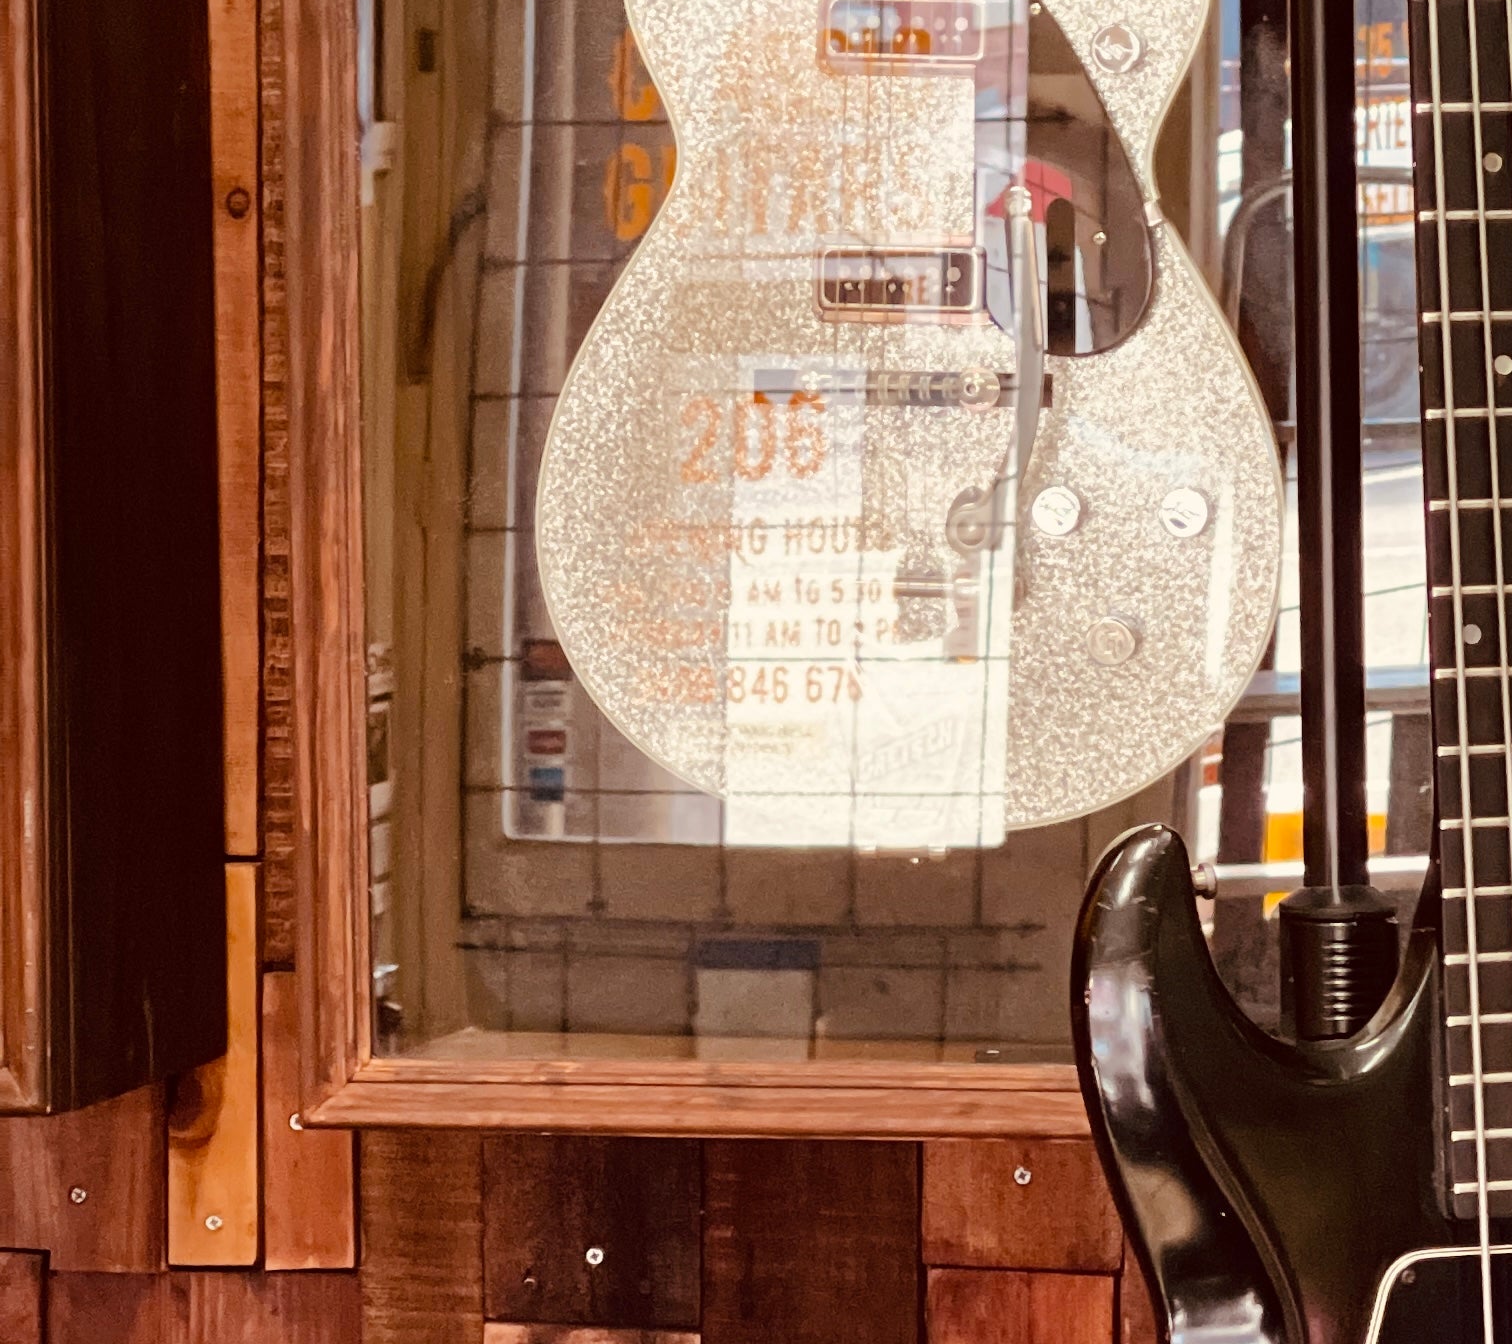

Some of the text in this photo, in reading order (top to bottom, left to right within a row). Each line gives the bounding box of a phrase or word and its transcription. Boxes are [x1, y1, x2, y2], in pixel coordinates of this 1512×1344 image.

[680, 390, 826, 483] 206
[765, 619, 801, 647] AM
[815, 618, 841, 646] TO
